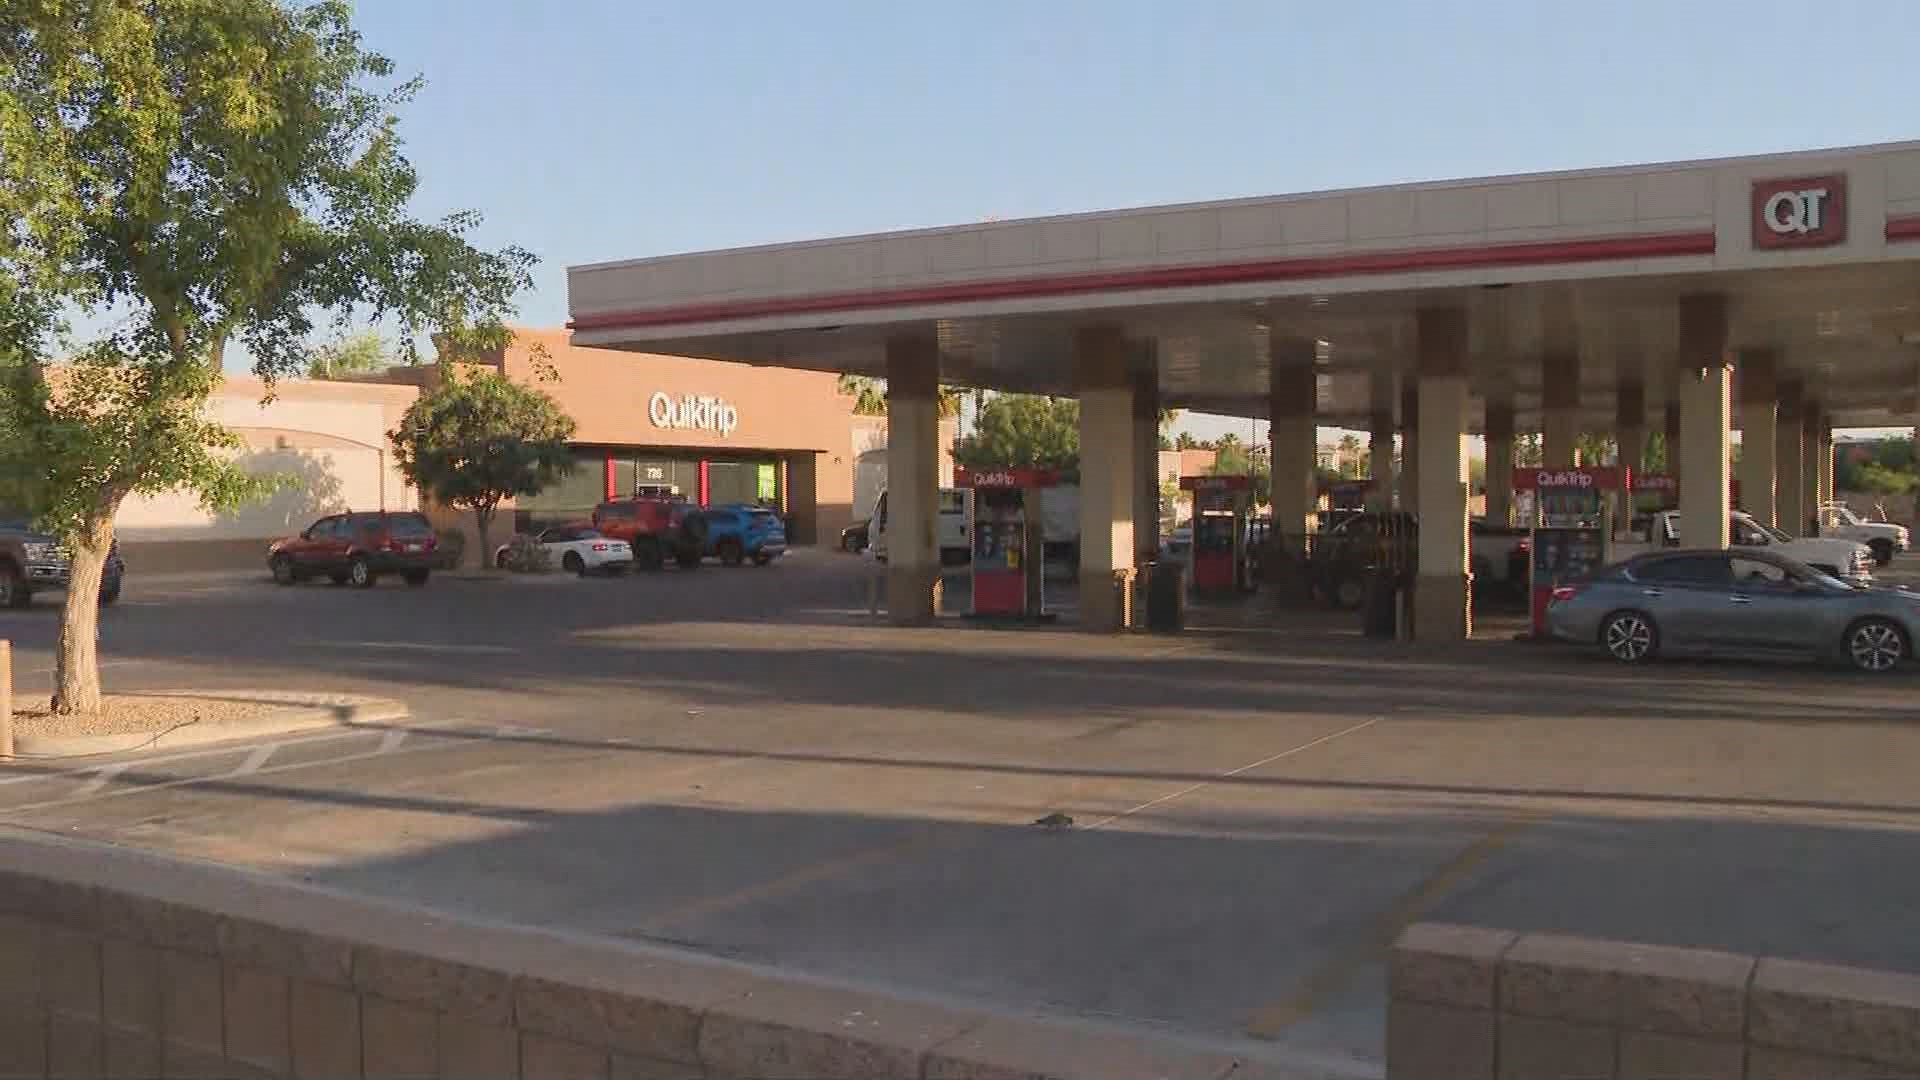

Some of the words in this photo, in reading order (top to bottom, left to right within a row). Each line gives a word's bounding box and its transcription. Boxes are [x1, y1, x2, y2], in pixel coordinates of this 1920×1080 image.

[1764, 188, 1827, 233] QT
[647, 391, 738, 438] QuikTrip
[1536, 470, 1593, 488] QuikTrip
